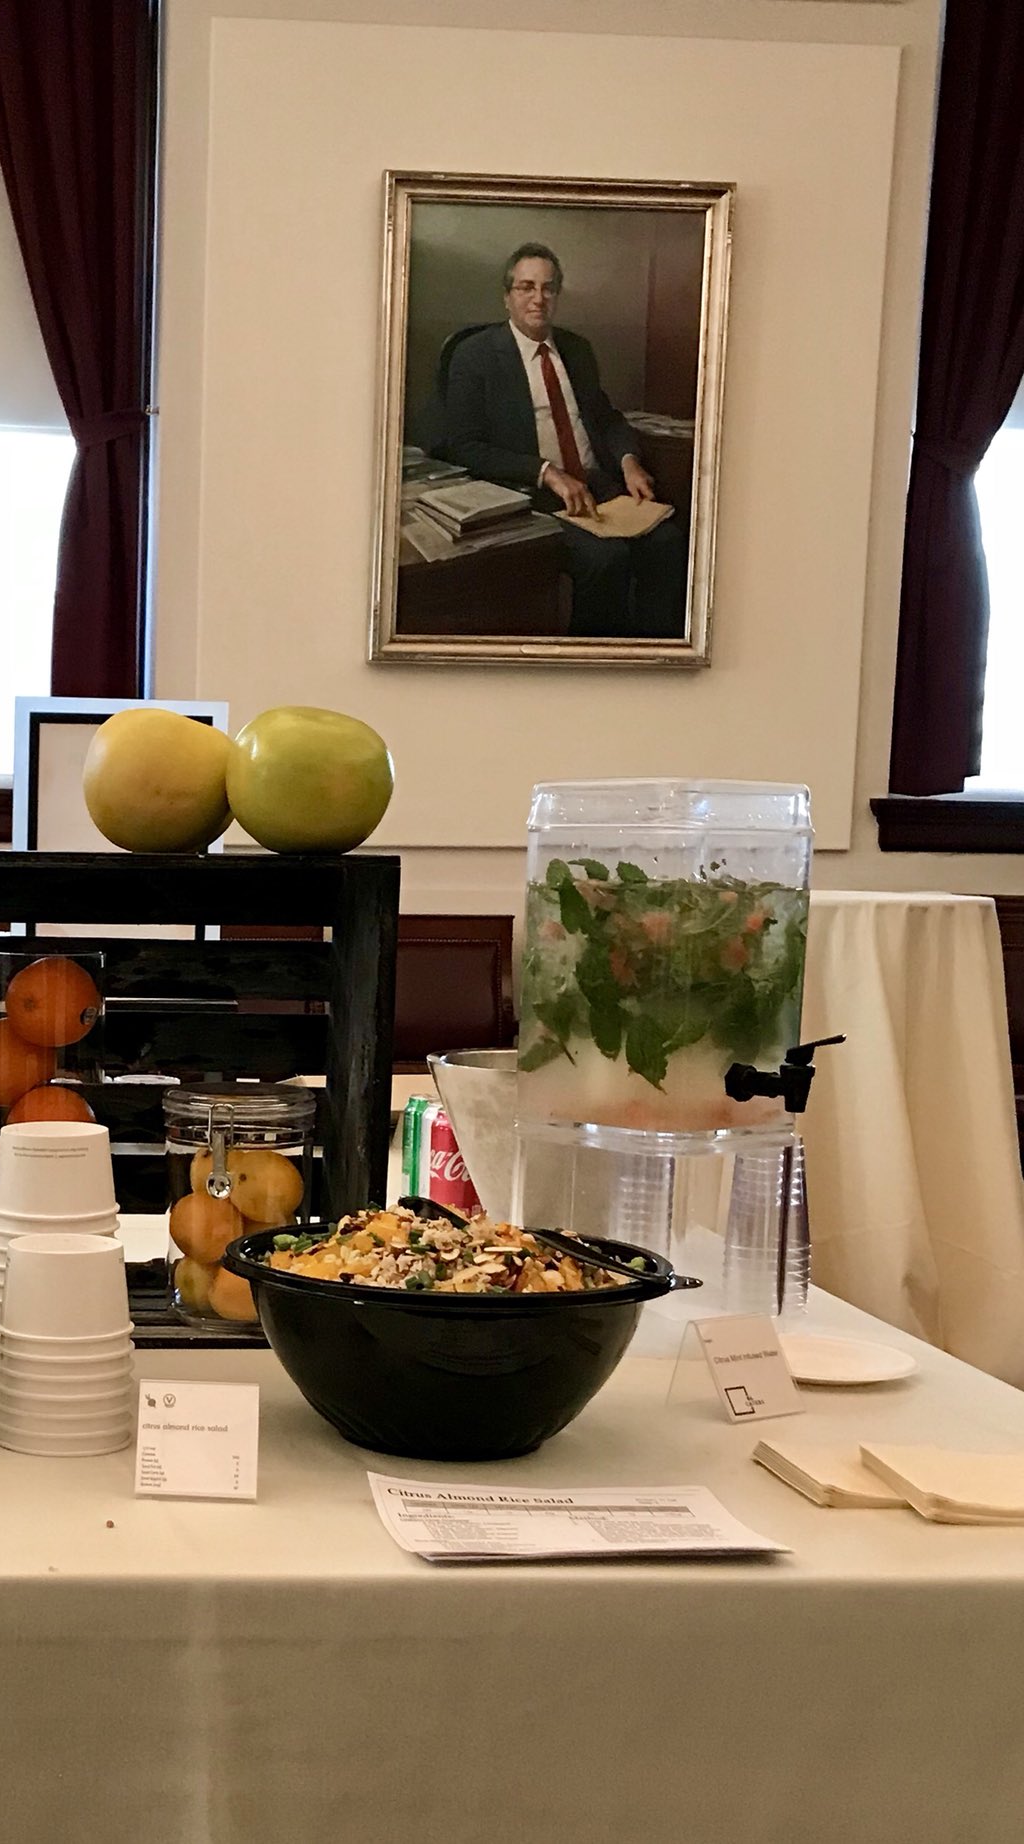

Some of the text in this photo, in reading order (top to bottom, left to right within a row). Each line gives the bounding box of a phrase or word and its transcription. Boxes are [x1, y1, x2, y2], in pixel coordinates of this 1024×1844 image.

[162, 1422, 190, 1431] almond
[207, 1424, 228, 1432] salad
[387, 1487, 432, 1499] Citrus
[437, 1493, 494, 1503] Almond
[499, 1496, 530, 1504] Rice
